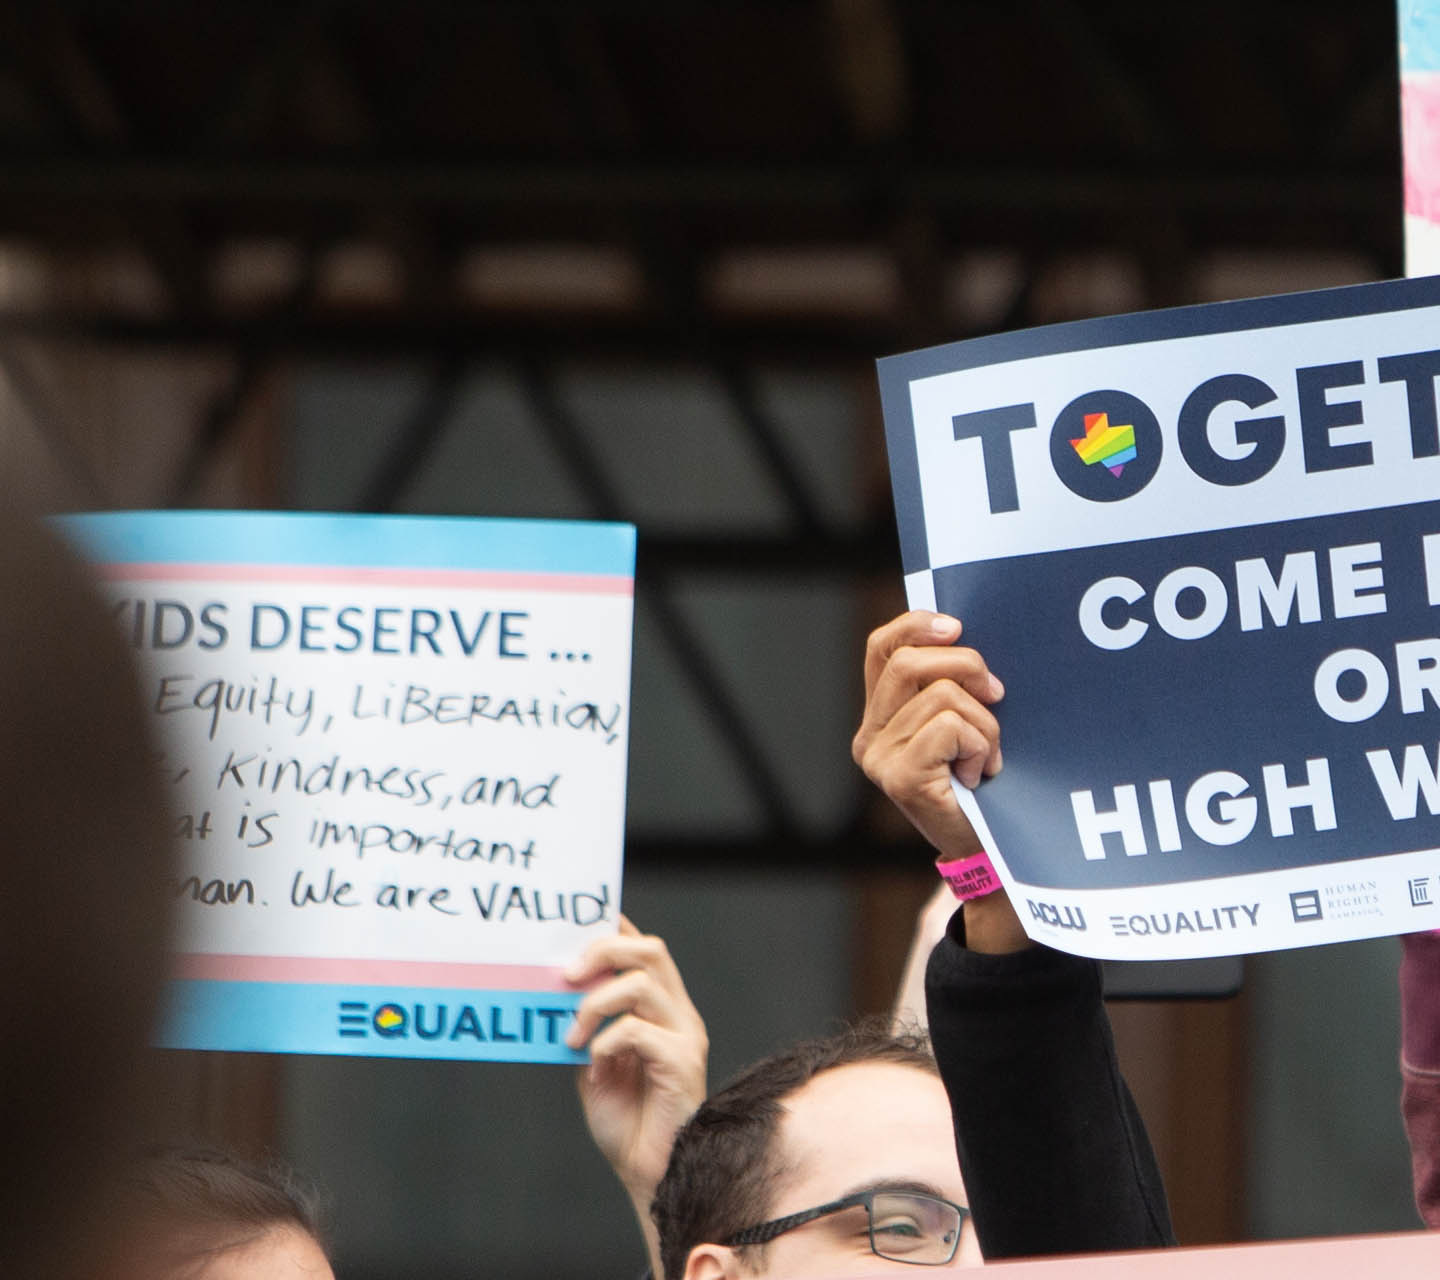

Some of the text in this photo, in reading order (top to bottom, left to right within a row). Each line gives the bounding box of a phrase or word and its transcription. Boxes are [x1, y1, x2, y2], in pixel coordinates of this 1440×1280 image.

[1077, 540, 1387, 652] COME
[114, 598, 230, 652] IDS
[250, 603, 529, 660] DESERVE
[238, 801, 281, 849] is
[1069, 756, 1338, 861] HIGH
[290, 868, 361, 909] We
[375, 885, 462, 917] are
[1325, 880, 1377, 897] HUMAN
[1328, 894, 1380, 910] RIGHTS
[1027, 899, 1088, 931] ACLU
[1110, 903, 1260, 936] EQUALITY
[338, 1000, 579, 1045] EQUALIT
